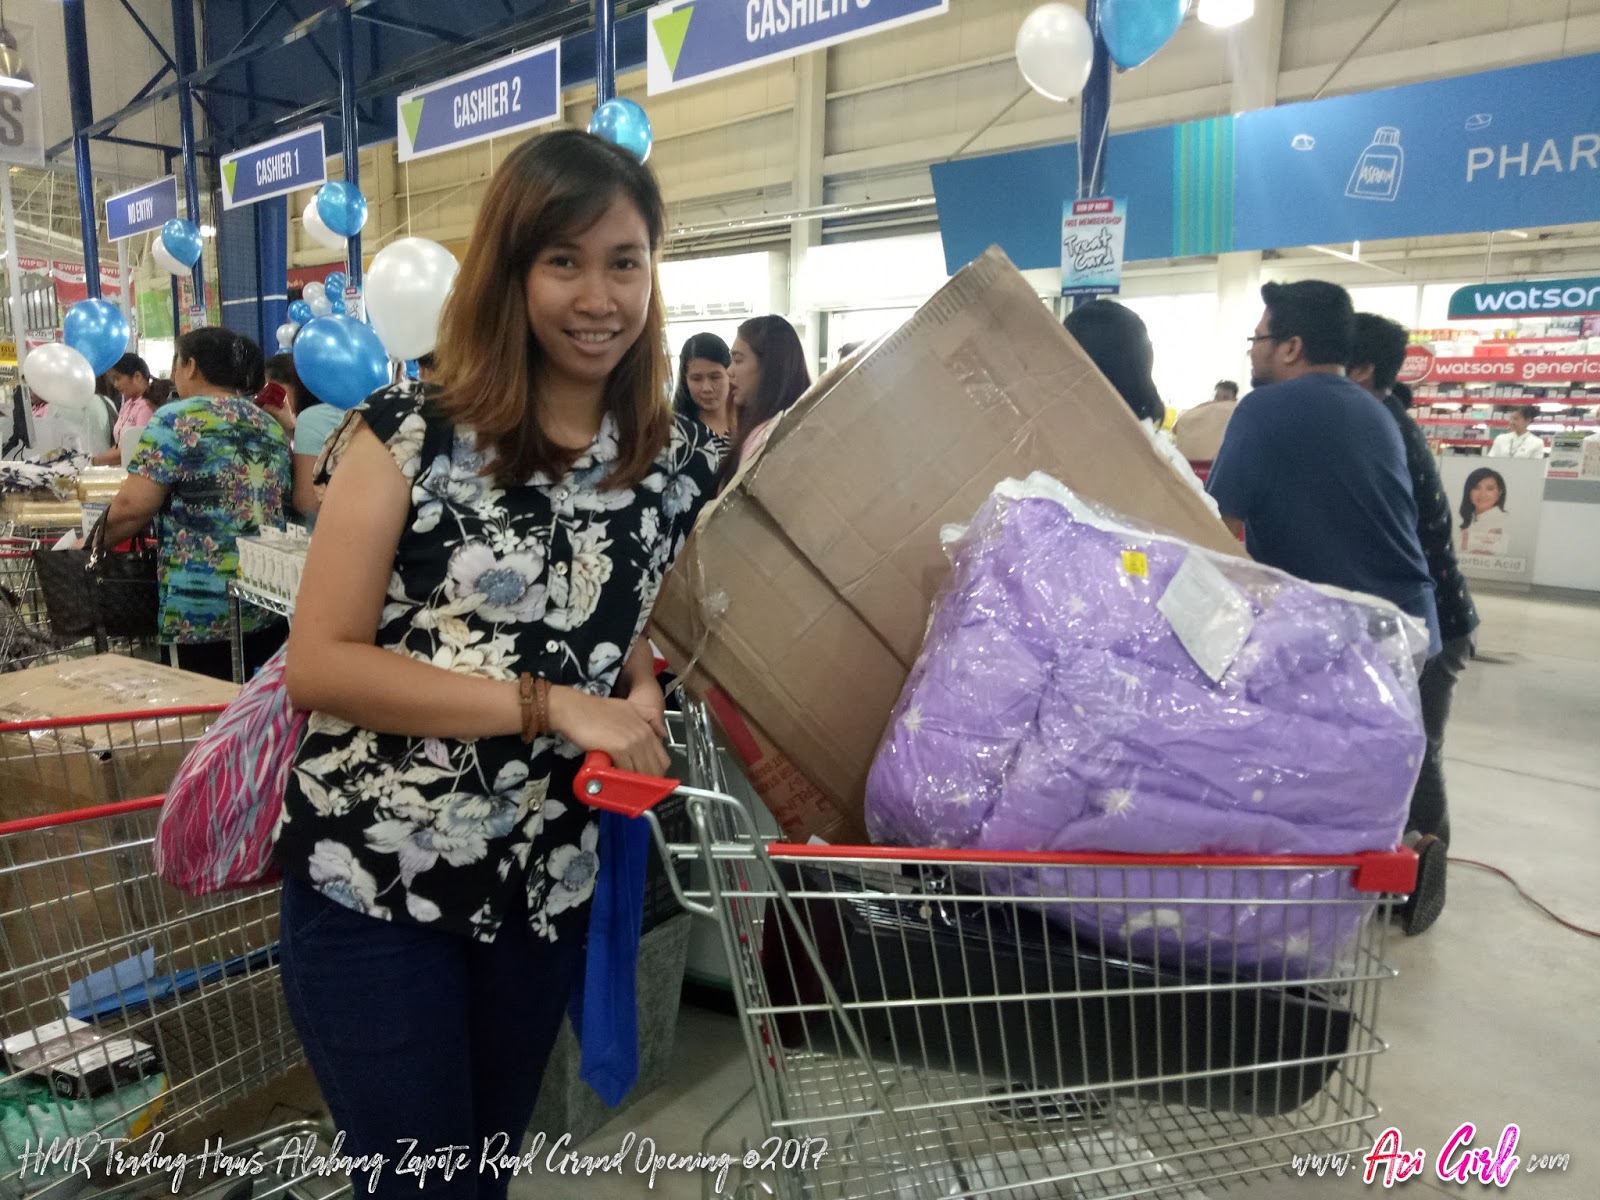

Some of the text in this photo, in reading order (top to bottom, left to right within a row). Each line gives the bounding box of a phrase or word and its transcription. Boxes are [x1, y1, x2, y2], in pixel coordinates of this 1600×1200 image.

[453, 76, 521, 129] CASHIER 2
[256, 148, 299, 186] CASHIER 1
[1466, 134, 1600, 182] PHAR
[127, 197, 154, 225] NO ENTRY
[1063, 227, 1112, 257] Treat
[1074, 247, 1114, 271] Card
[1435, 359, 1600, 379] watsons generic
